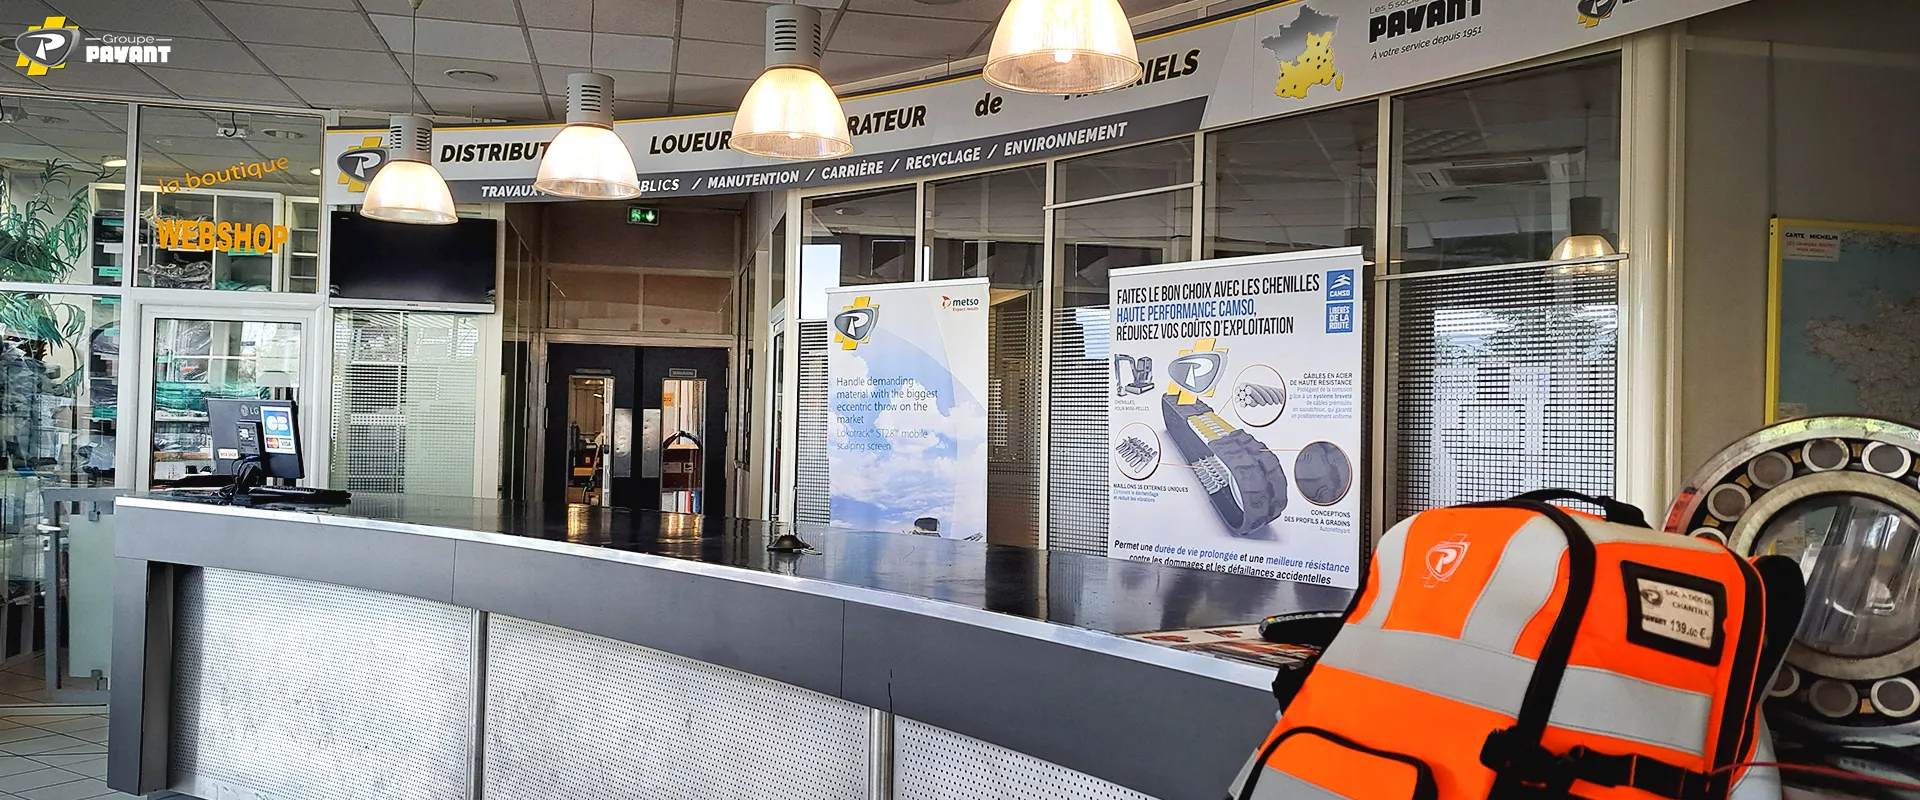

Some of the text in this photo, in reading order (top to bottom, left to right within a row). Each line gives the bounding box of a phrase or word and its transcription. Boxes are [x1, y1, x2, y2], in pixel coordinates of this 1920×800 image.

[1379, 47, 1399, 59] votre
[1402, 40, 1430, 54] service
[1432, 31, 1460, 45] depuis
[1463, 26, 1482, 37] 1951
[440, 142, 552, 162] DISTRIBUT
[848, 105, 927, 136] RATEUR
[975, 92, 1003, 117] de
[482, 185, 538, 198] TRAVAUX
[638, 179, 680, 192] BLICS
[707, 170, 800, 188] MANUTENTION
[821, 159, 884, 179] CARRIÈRE
[905, 147, 981, 170] RECYCLAGE
[1004, 121, 1128, 156] ENVIRONNEMENT
[158, 157, 289, 195] la boutique
[157, 219, 288, 254] WEBSHOP
[1117, 273, 1320, 304] FAITES LE BON CHOIX AVEC LES CHENILLES
[953, 298, 979, 306] metso
[1117, 298, 1257, 322] HAUTE PERFORMANCE CAMSO,
[1116, 316, 1293, 341] RÉDUISEZ VOS COÛTS D'EXPLOITATION
[836, 376, 914, 388] Handle demanding
[836, 388, 938, 401] material with the biggest
[250, 407, 260, 415] LG
[836, 401, 928, 411] eccentric throw on the
[836, 415, 864, 424] market
[902, 428, 928, 438] mobile
[836, 441, 891, 453] scalping screen
[1296, 517, 1318, 525] PROFILS
[1310, 509, 1351, 518] CONCEPTIONS
[1114, 540, 1350, 573] Permet une durée de vie prolongée et une meilleure résistance
[1152, 555, 1163, 564] les
[1164, 557, 1204, 570] dommages
[1206, 562, 1213, 571] et
[1215, 563, 1226, 572] les
[1228, 564, 1274, 578] défaillances
[1276, 571, 1332, 585] accidentelles
